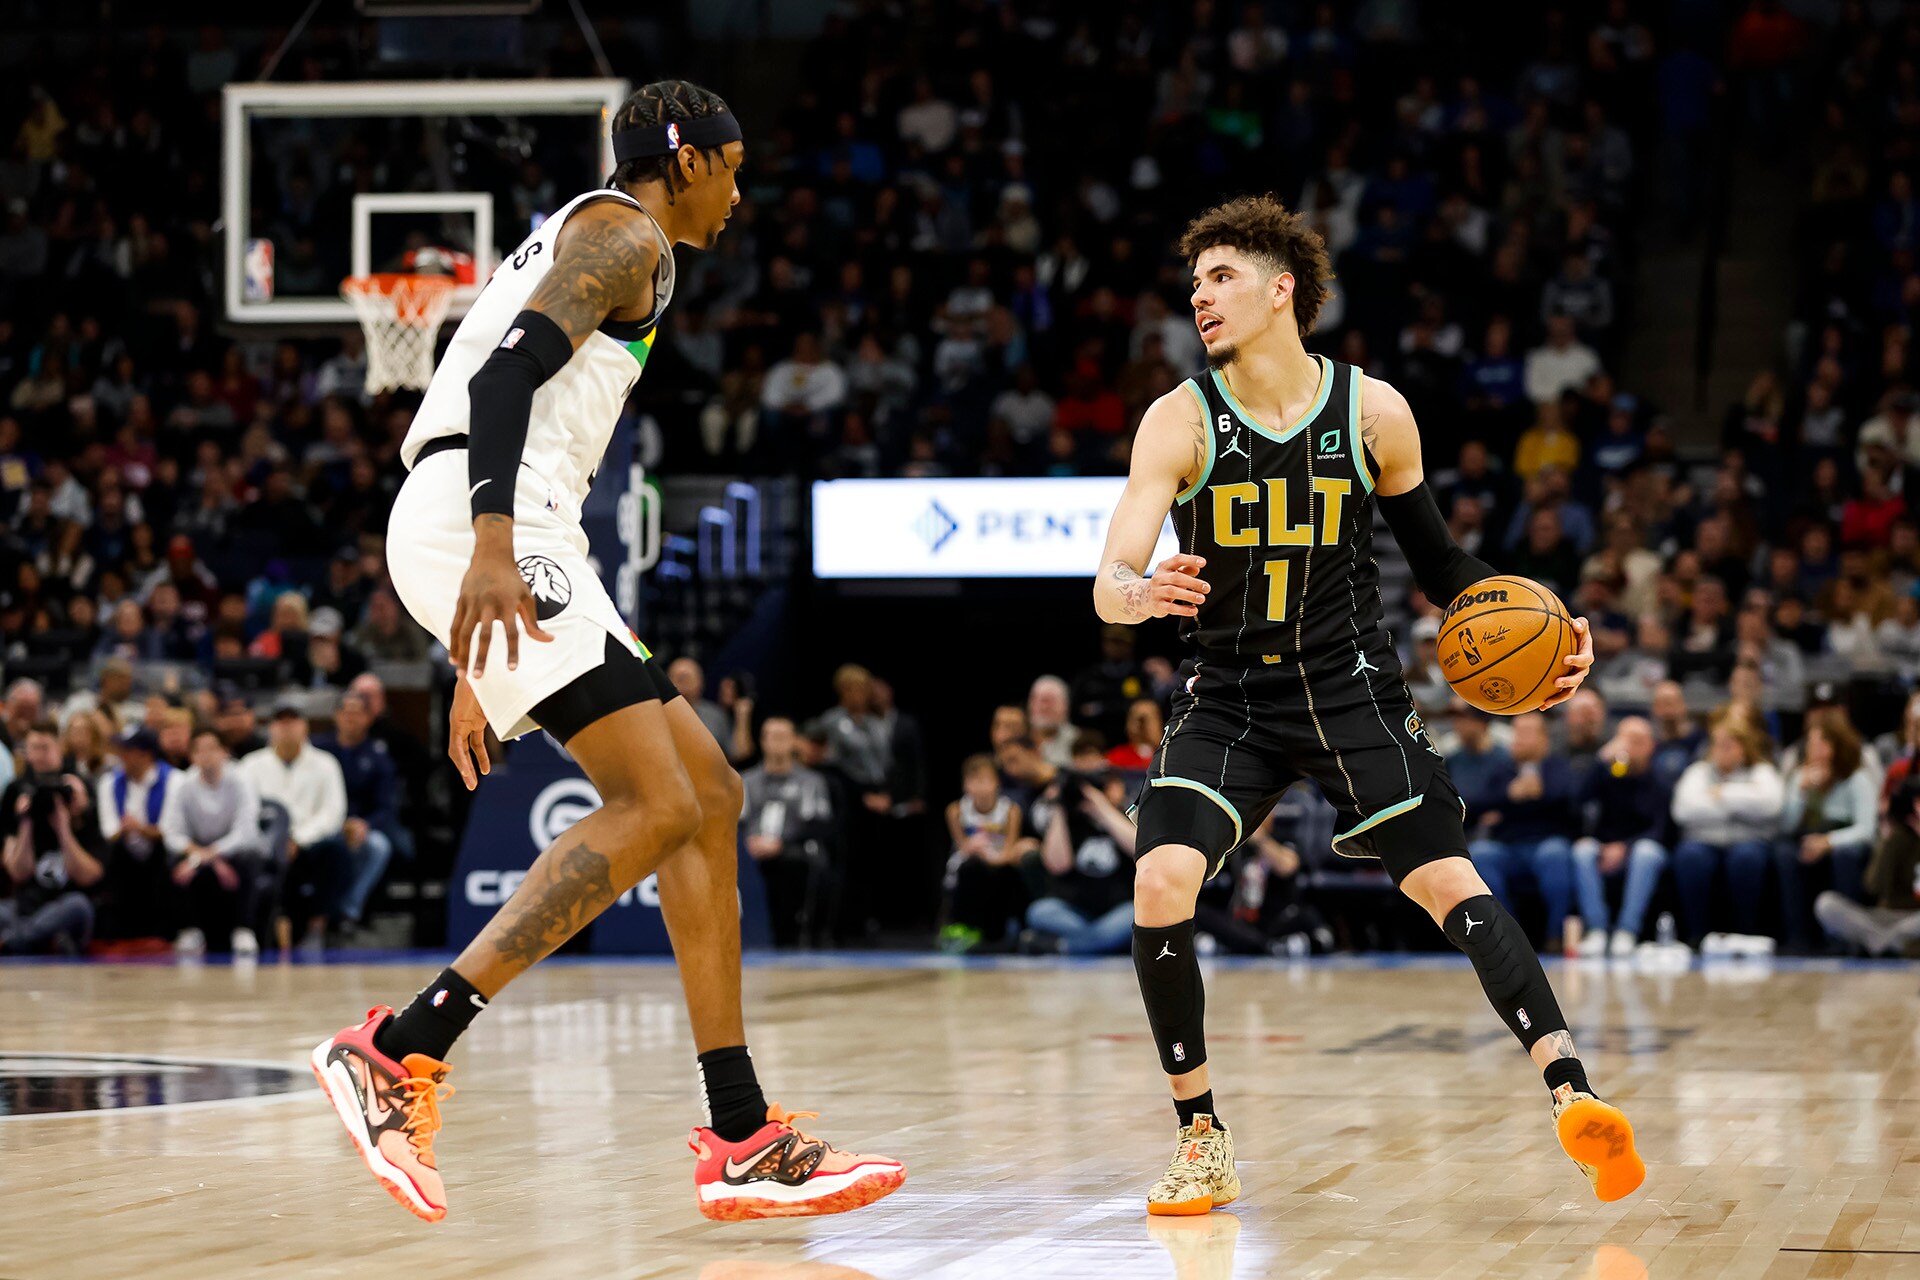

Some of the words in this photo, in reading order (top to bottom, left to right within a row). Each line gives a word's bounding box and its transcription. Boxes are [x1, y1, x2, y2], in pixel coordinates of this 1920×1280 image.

[511, 236, 543, 271] S
[1217, 413, 1231, 433] 6
[1207, 476, 1352, 547] CLT
[1263, 559, 1289, 622] 1
